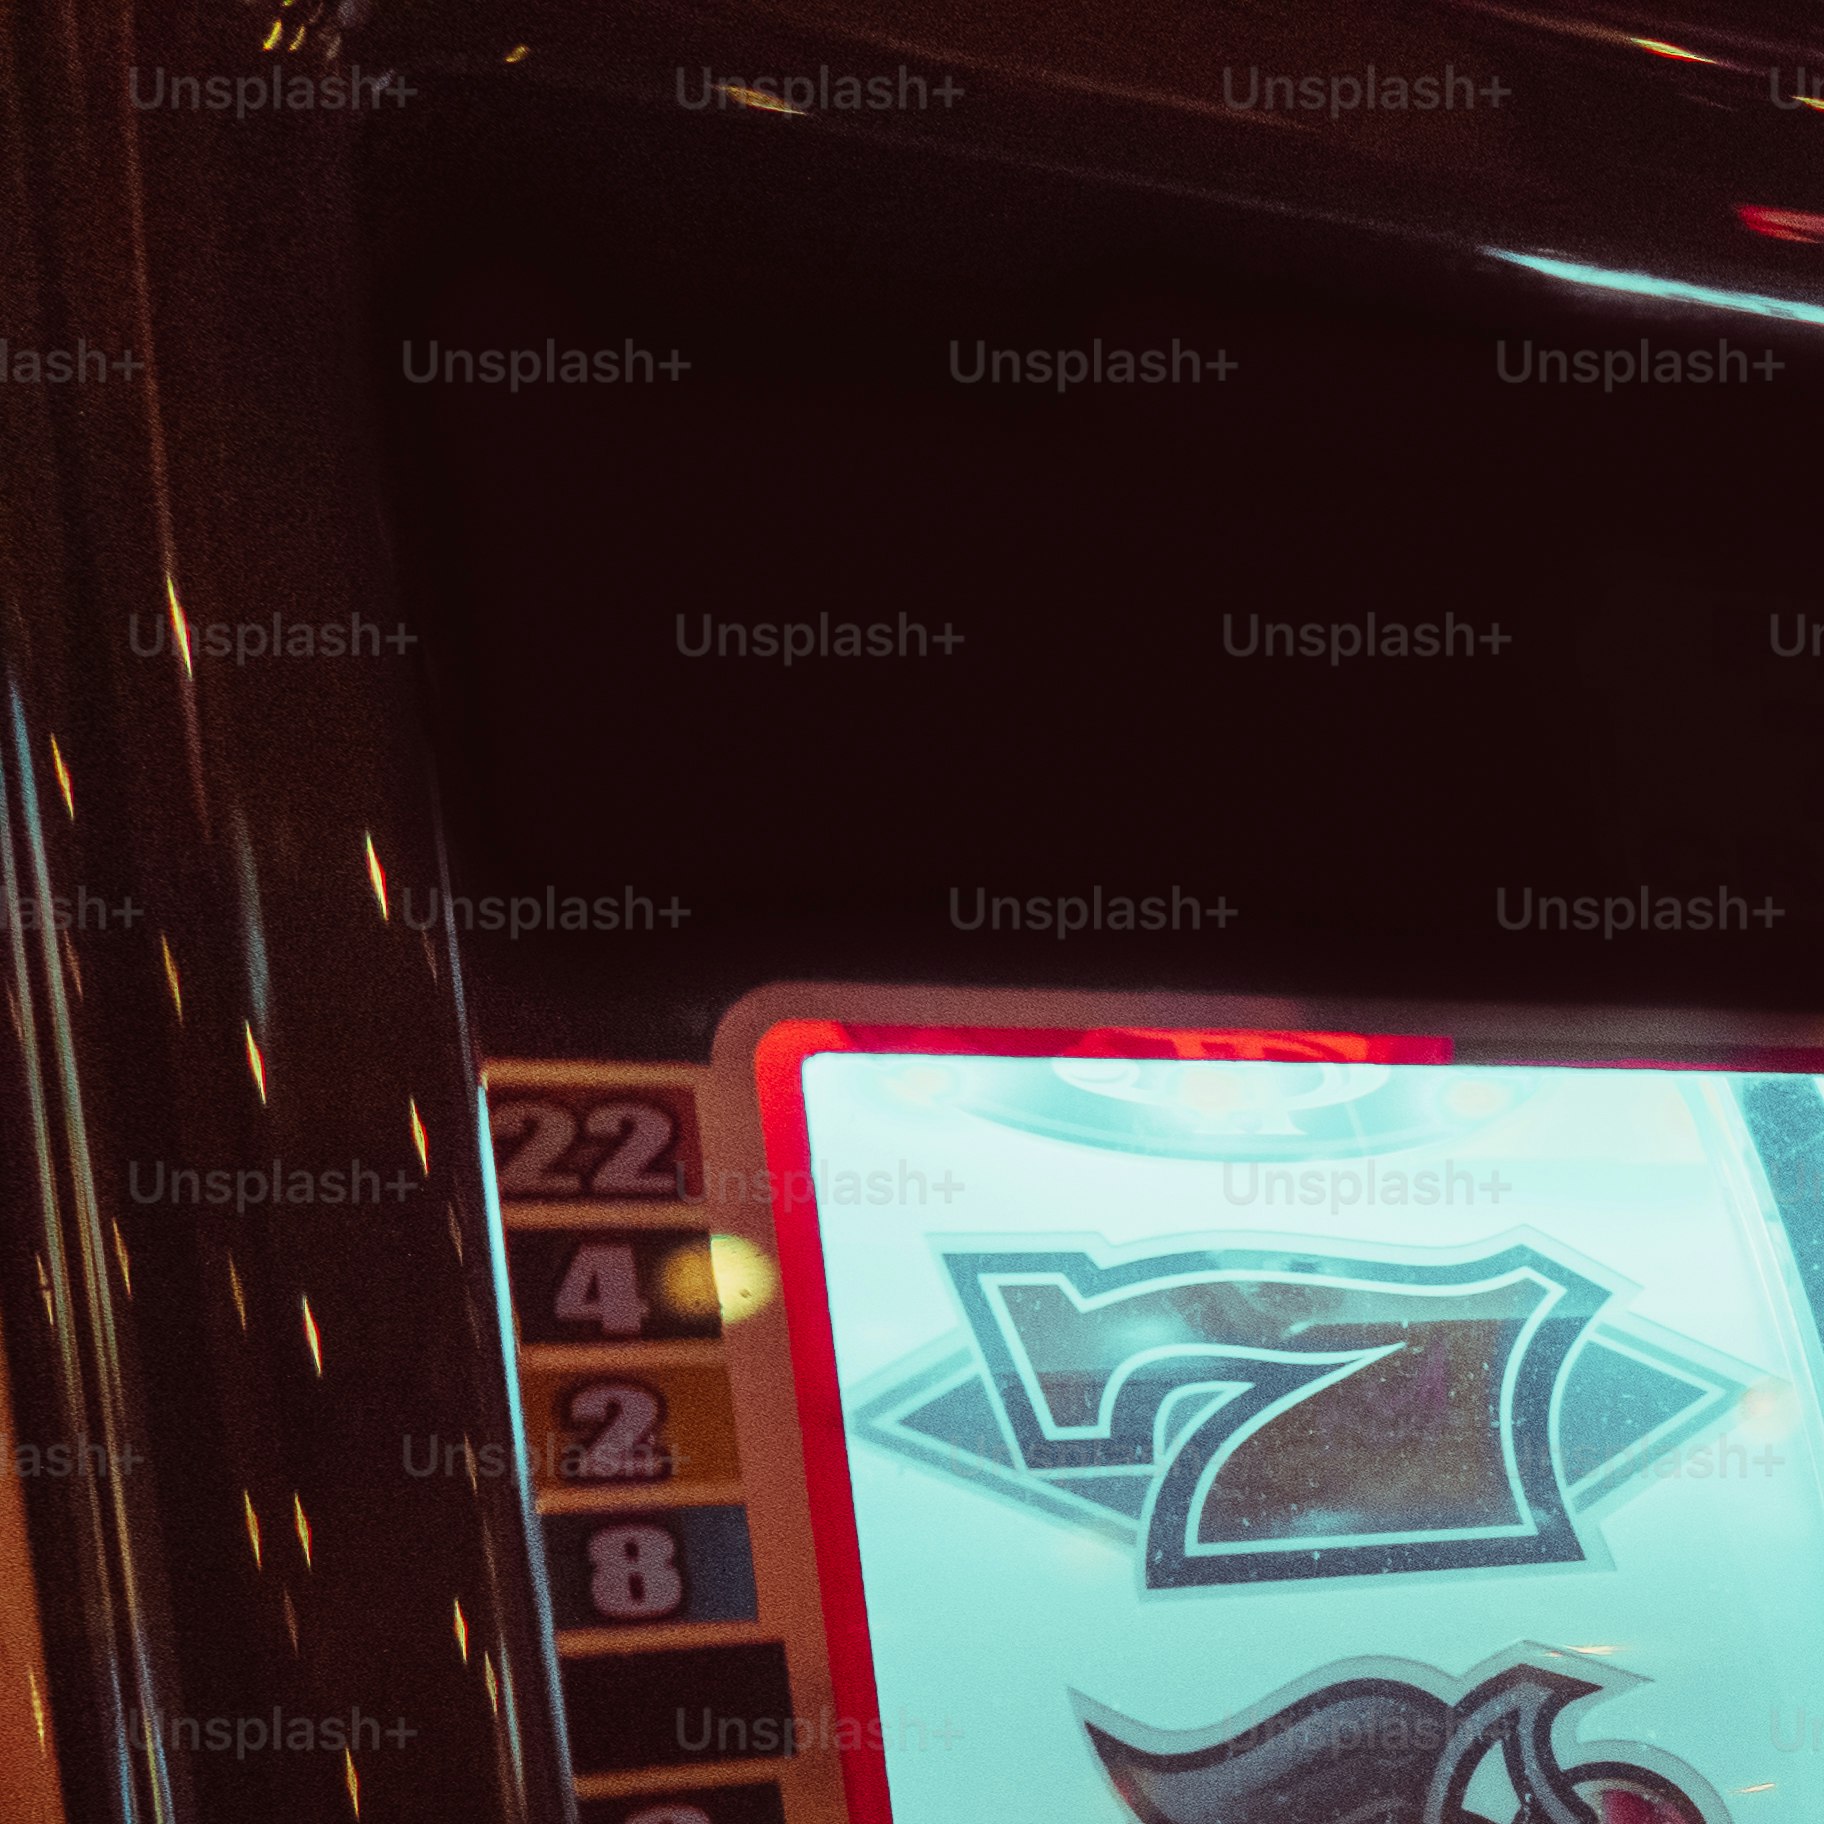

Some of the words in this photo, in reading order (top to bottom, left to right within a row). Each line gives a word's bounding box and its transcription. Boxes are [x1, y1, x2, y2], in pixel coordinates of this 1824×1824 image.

[494, 1103, 676, 1196] 22
[555, 1243, 648, 1335] 4
[569, 1384, 660, 1481] 2
[941, 1244, 1612, 1590] 7
[588, 1525, 682, 1616] 8
